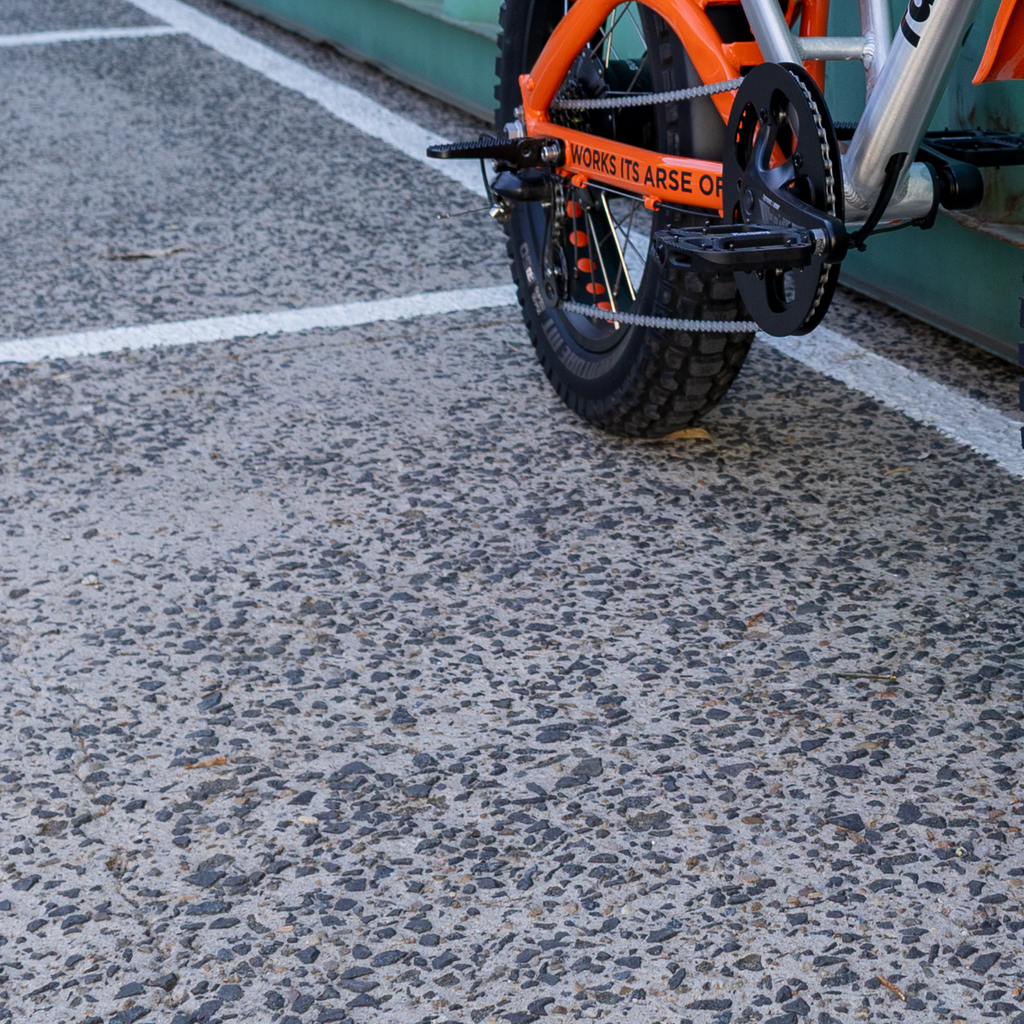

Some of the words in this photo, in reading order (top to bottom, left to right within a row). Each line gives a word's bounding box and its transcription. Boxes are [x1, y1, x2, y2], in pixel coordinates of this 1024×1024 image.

[571, 143, 617, 176] WORKS
[620, 157, 640, 183] ITS
[644, 165, 693, 194] ARSE
